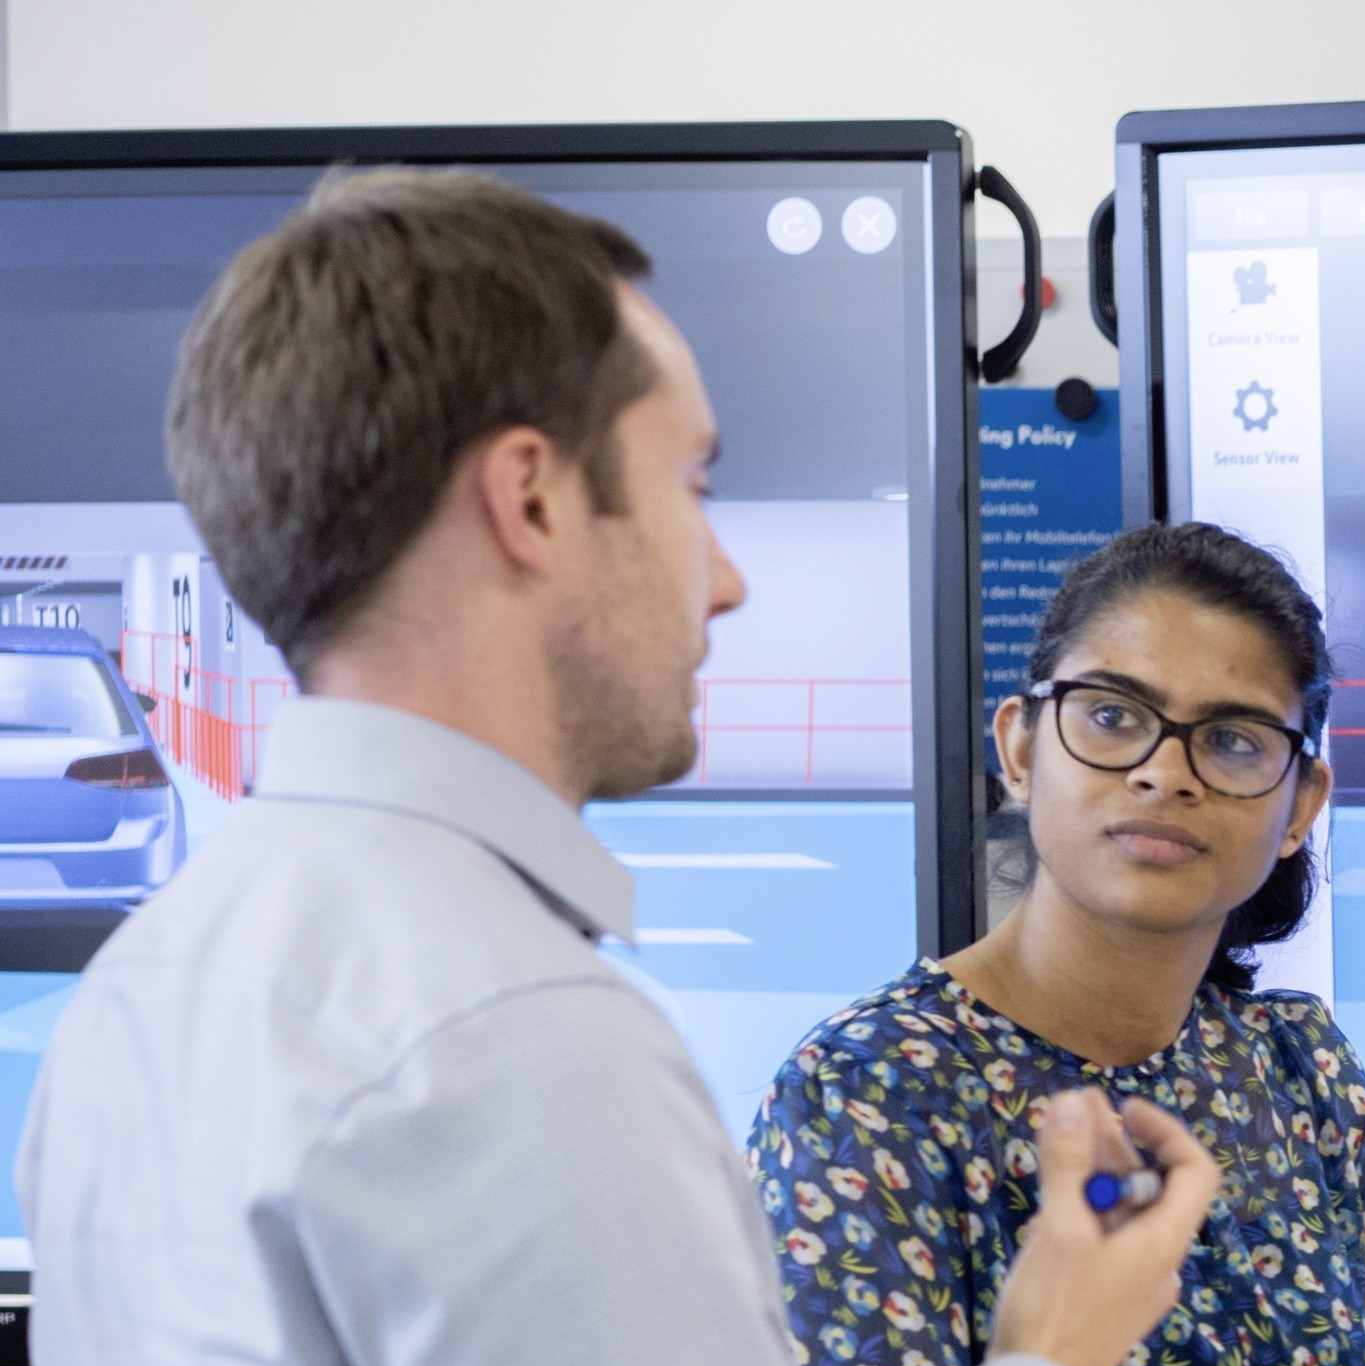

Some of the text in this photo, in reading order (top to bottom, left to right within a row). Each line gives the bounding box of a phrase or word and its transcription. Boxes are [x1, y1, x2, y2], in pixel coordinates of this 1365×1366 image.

[1263, 330, 1300, 345] View
[1018, 424, 1077, 449] Policy
[1213, 450, 1300, 466] Sensor View
[36, 604, 79, 628] T10
